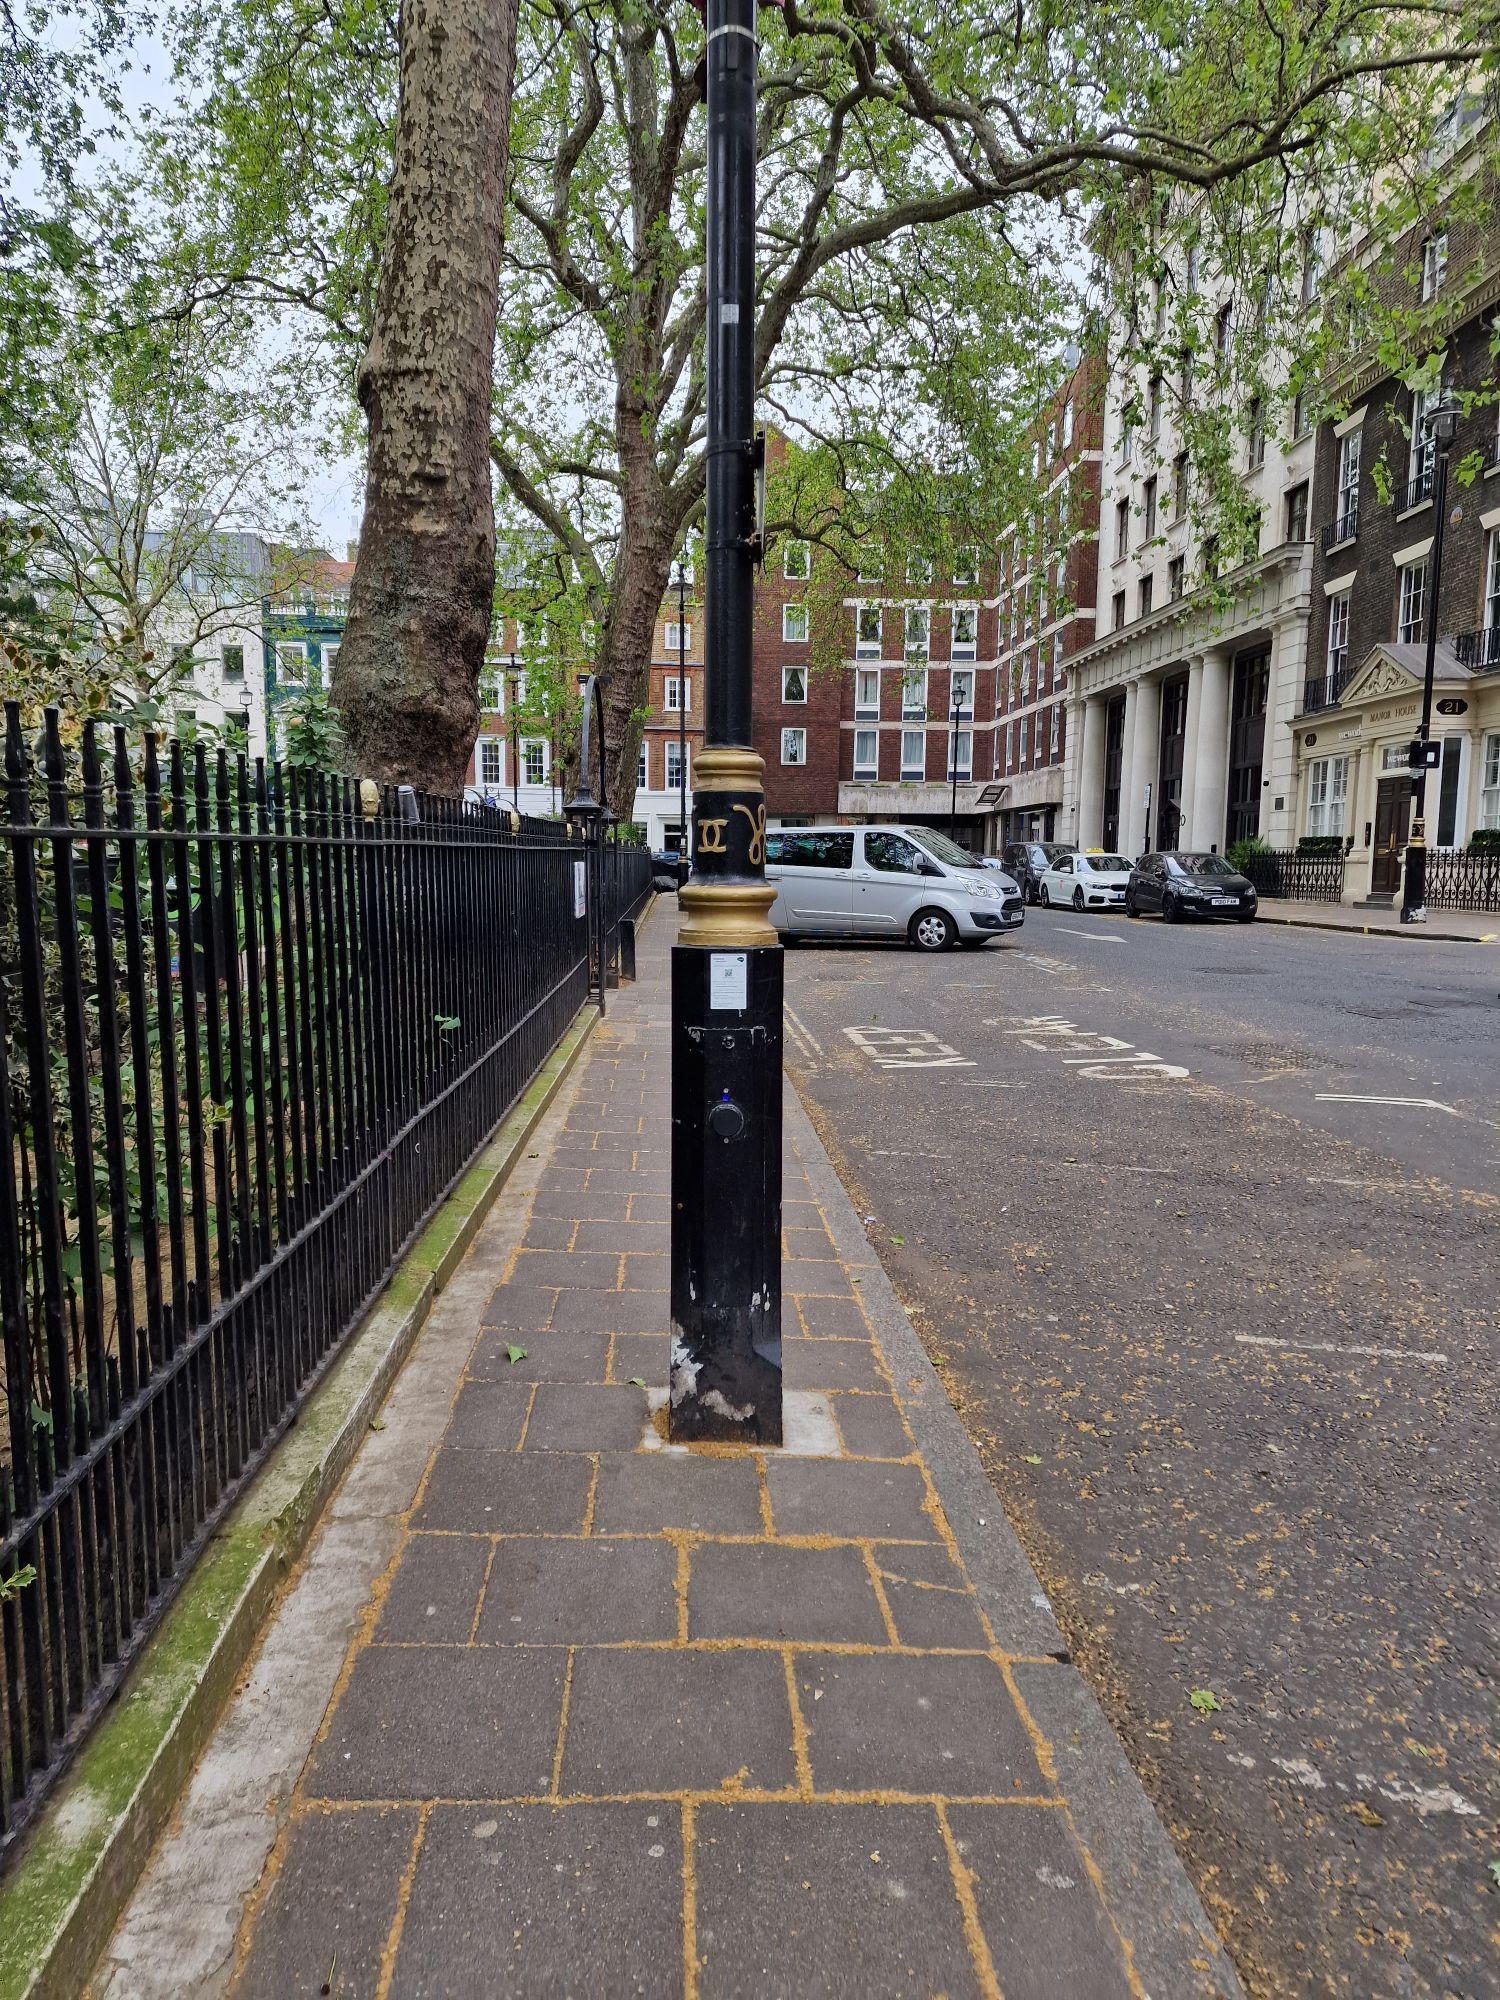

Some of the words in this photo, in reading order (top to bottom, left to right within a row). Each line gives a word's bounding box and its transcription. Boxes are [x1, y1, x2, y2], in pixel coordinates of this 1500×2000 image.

[1370, 710, 1391, 722] MANOR
[1395, 704, 1417, 718] HOUSE
[1444, 701, 1459, 713] 21
[842, 1025, 978, 1069] KEEP
[982, 1015, 1190, 1078] CLEAR
